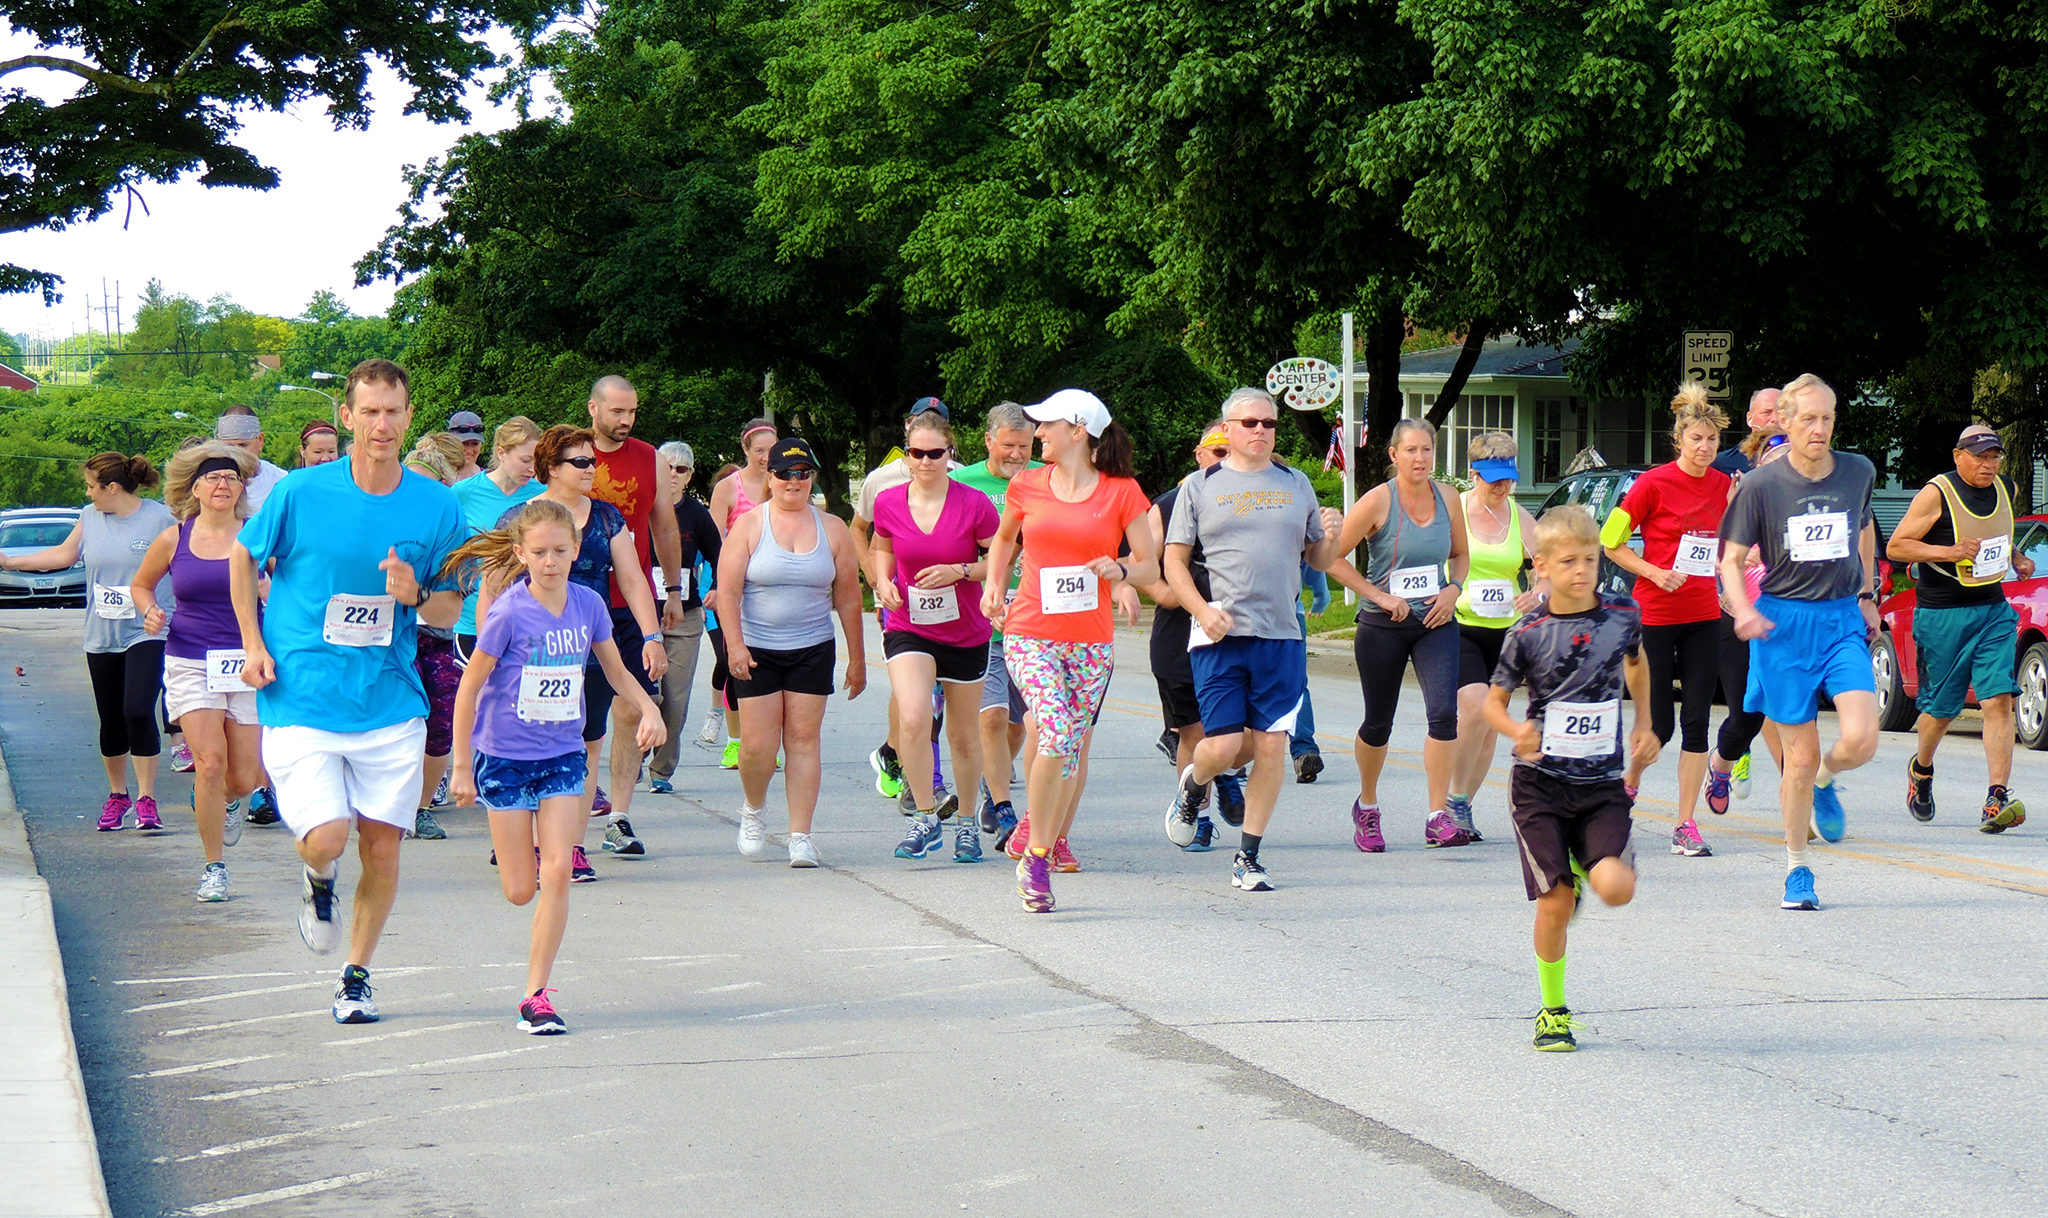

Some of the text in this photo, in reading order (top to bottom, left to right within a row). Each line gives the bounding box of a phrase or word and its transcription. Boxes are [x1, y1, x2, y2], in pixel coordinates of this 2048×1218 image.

[1688, 338, 1728, 348] SPEED
[1691, 353, 1723, 362] LIMIT
[1288, 361, 1315, 373] ART
[1276, 372, 1327, 385] CENTER
[1688, 367, 1727, 393] 25
[1242, 491, 1294, 499] SCRATCH
[1804, 524, 1833, 542] 227
[1690, 546, 1711, 560] 251
[1983, 545, 2002, 561] 257
[1056, 576, 1085, 594] 254
[1403, 576, 1427, 589] 233
[103, 591, 123, 605] 235
[1482, 589, 1504, 602] 225
[919, 597, 945, 610] 232
[344, 606, 379, 625] 224
[545, 625, 588, 656] GIRLS
[538, 679, 571, 698] 223
[1564, 714, 1602, 735] 264
